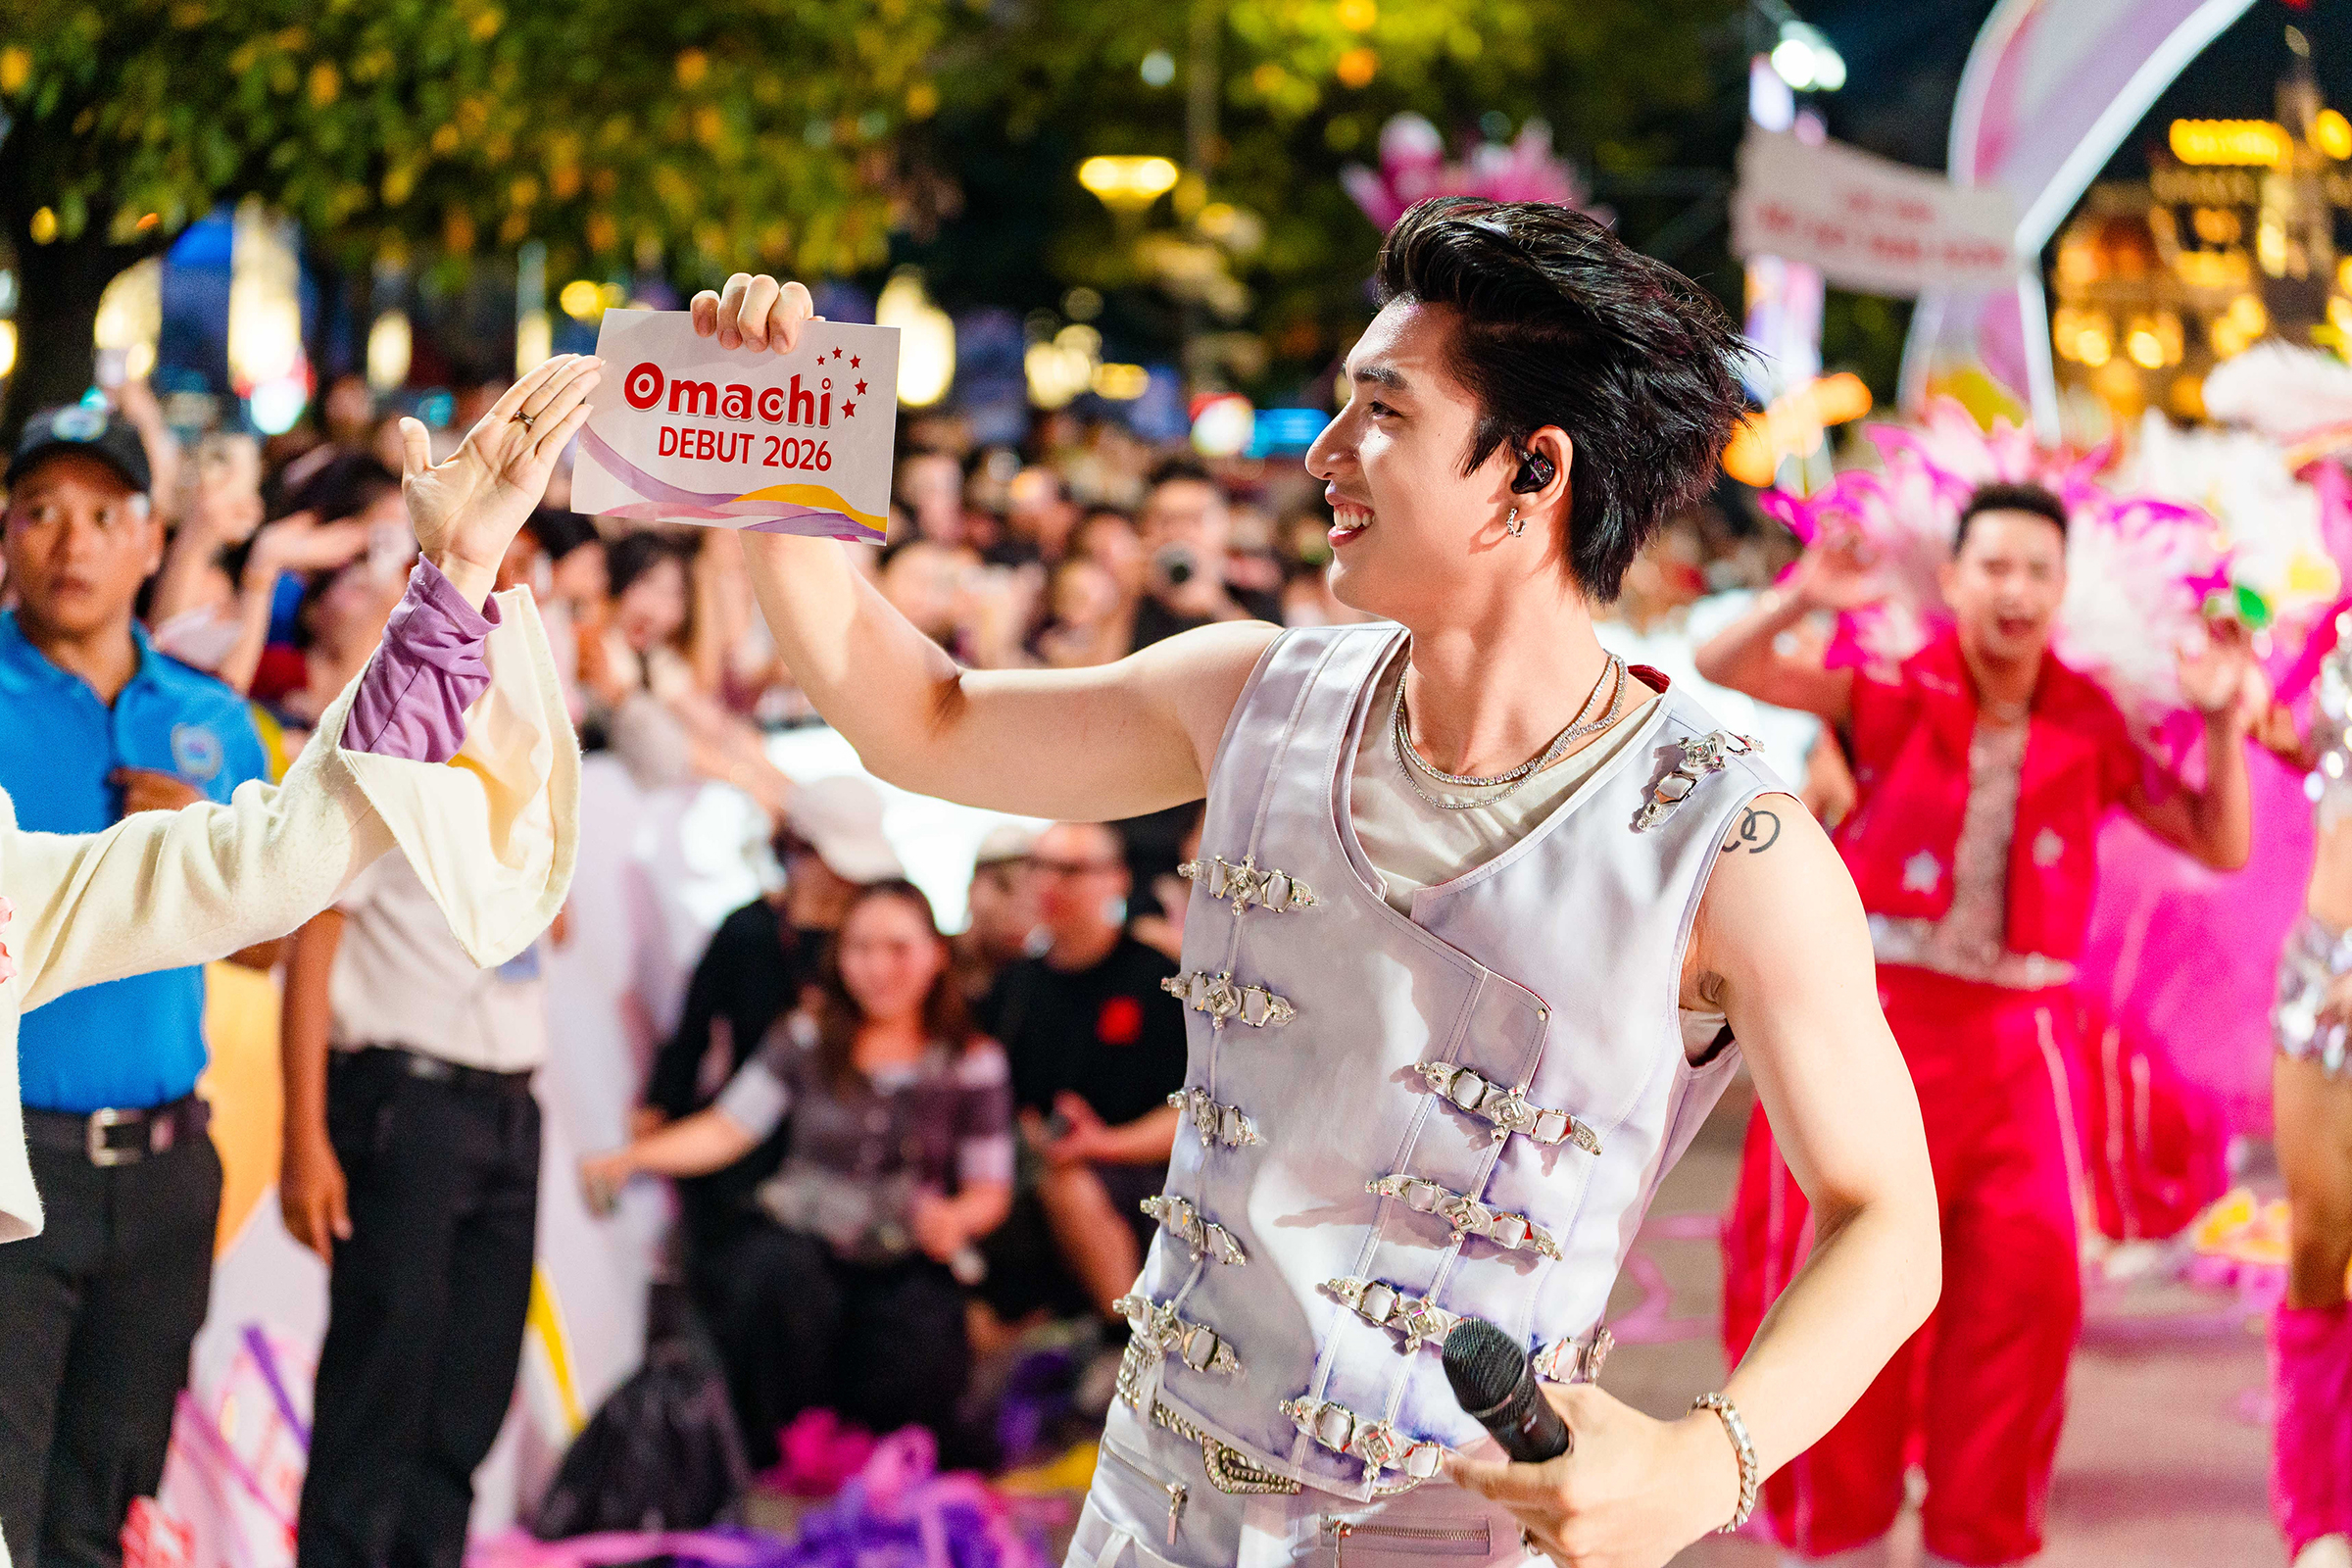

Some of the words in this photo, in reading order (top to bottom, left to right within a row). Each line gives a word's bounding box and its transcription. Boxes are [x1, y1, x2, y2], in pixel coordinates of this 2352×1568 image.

[623, 362, 832, 427] Omachi
[658, 426, 755, 464] DEBUT
[762, 435, 832, 471] 2026
